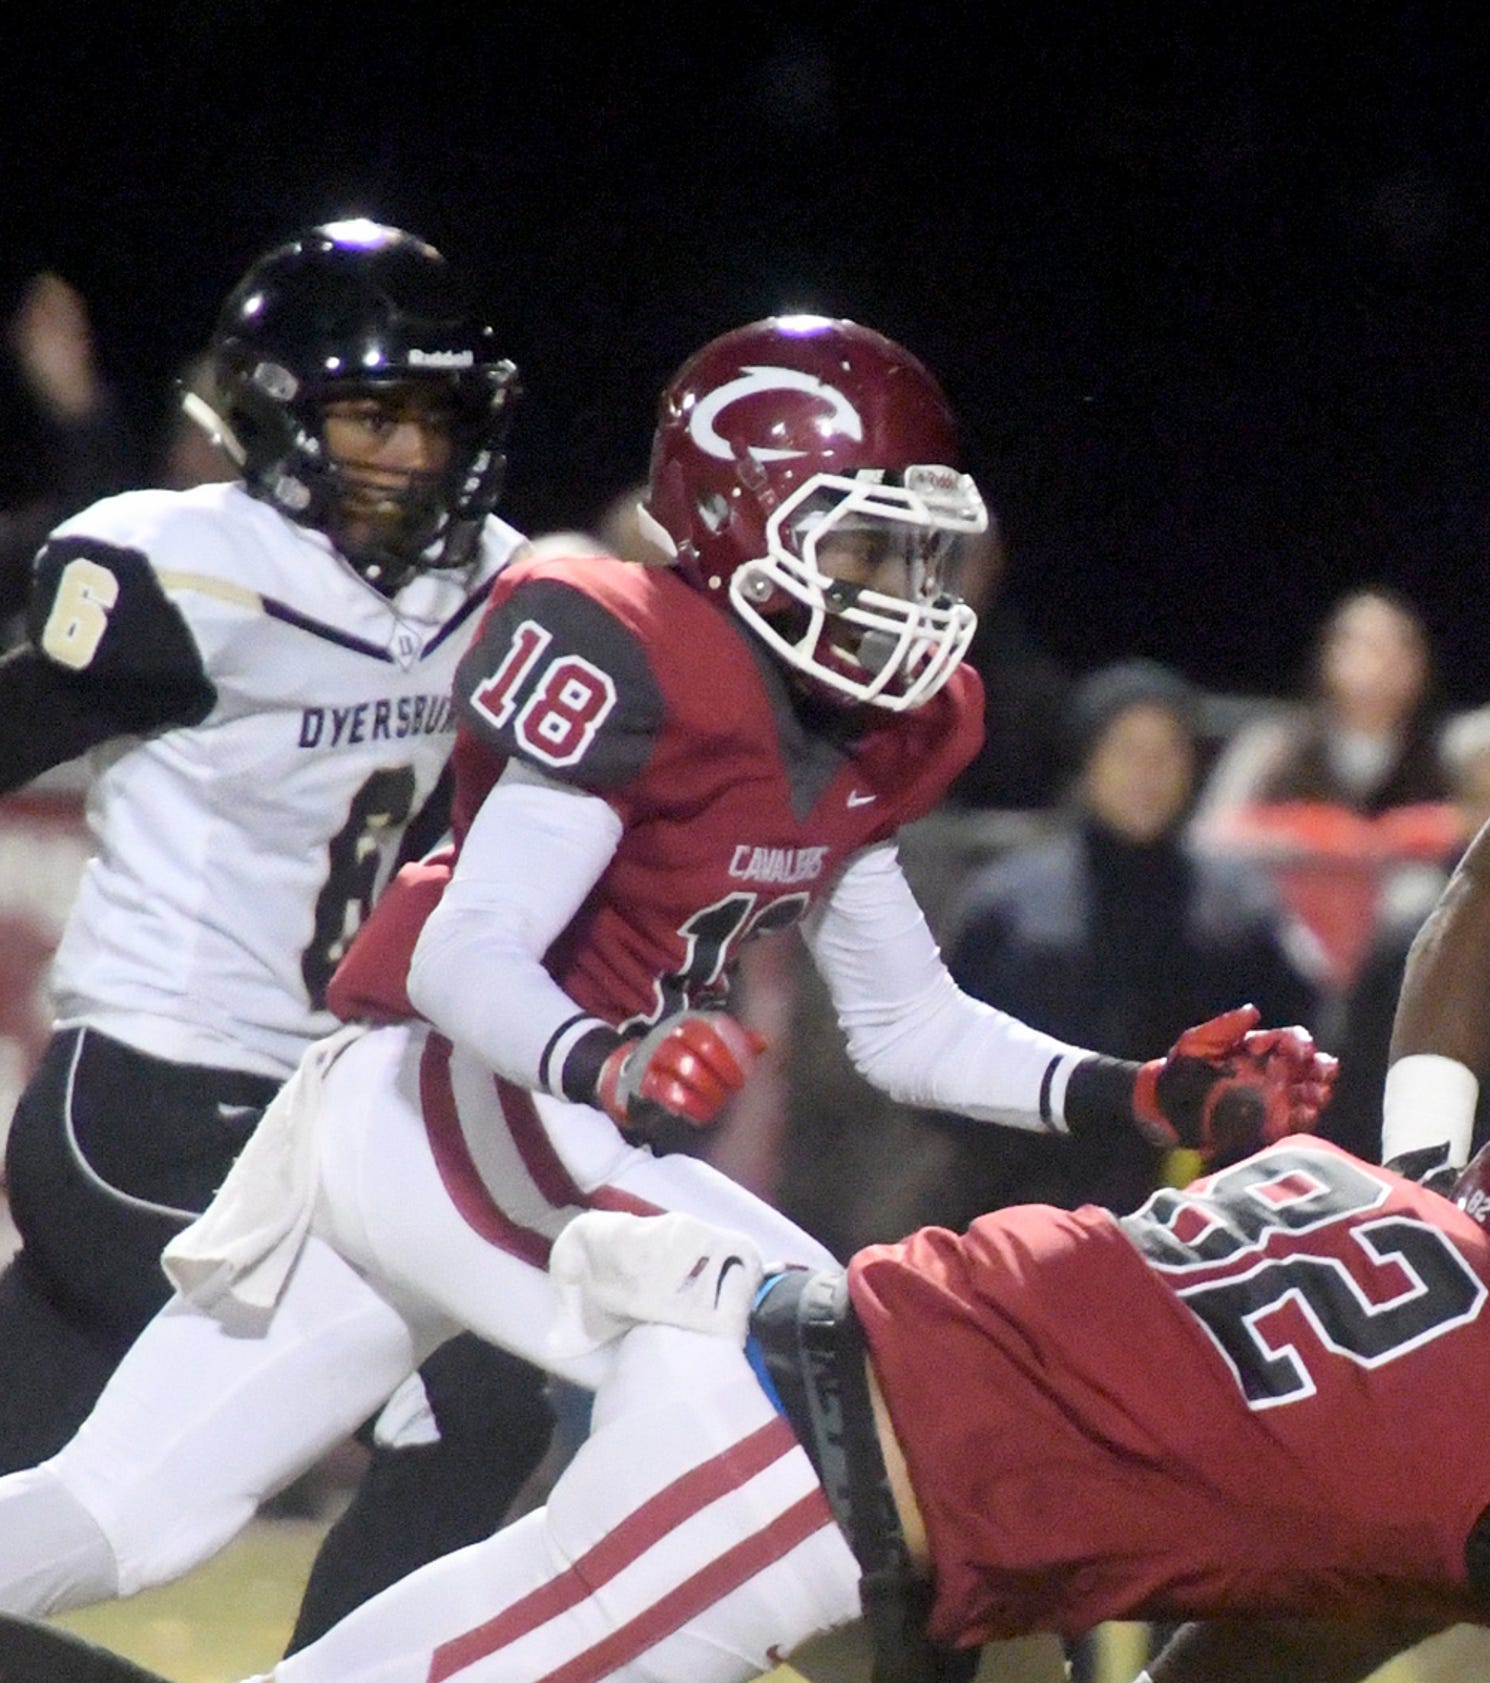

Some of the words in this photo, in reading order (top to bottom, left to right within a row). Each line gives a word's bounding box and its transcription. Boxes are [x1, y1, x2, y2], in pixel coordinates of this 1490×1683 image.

[40, 557, 119, 671] 6
[298, 695, 457, 750] DYERSBUR
[470, 619, 618, 768] 18
[1120, 1146, 1490, 1411] 82
